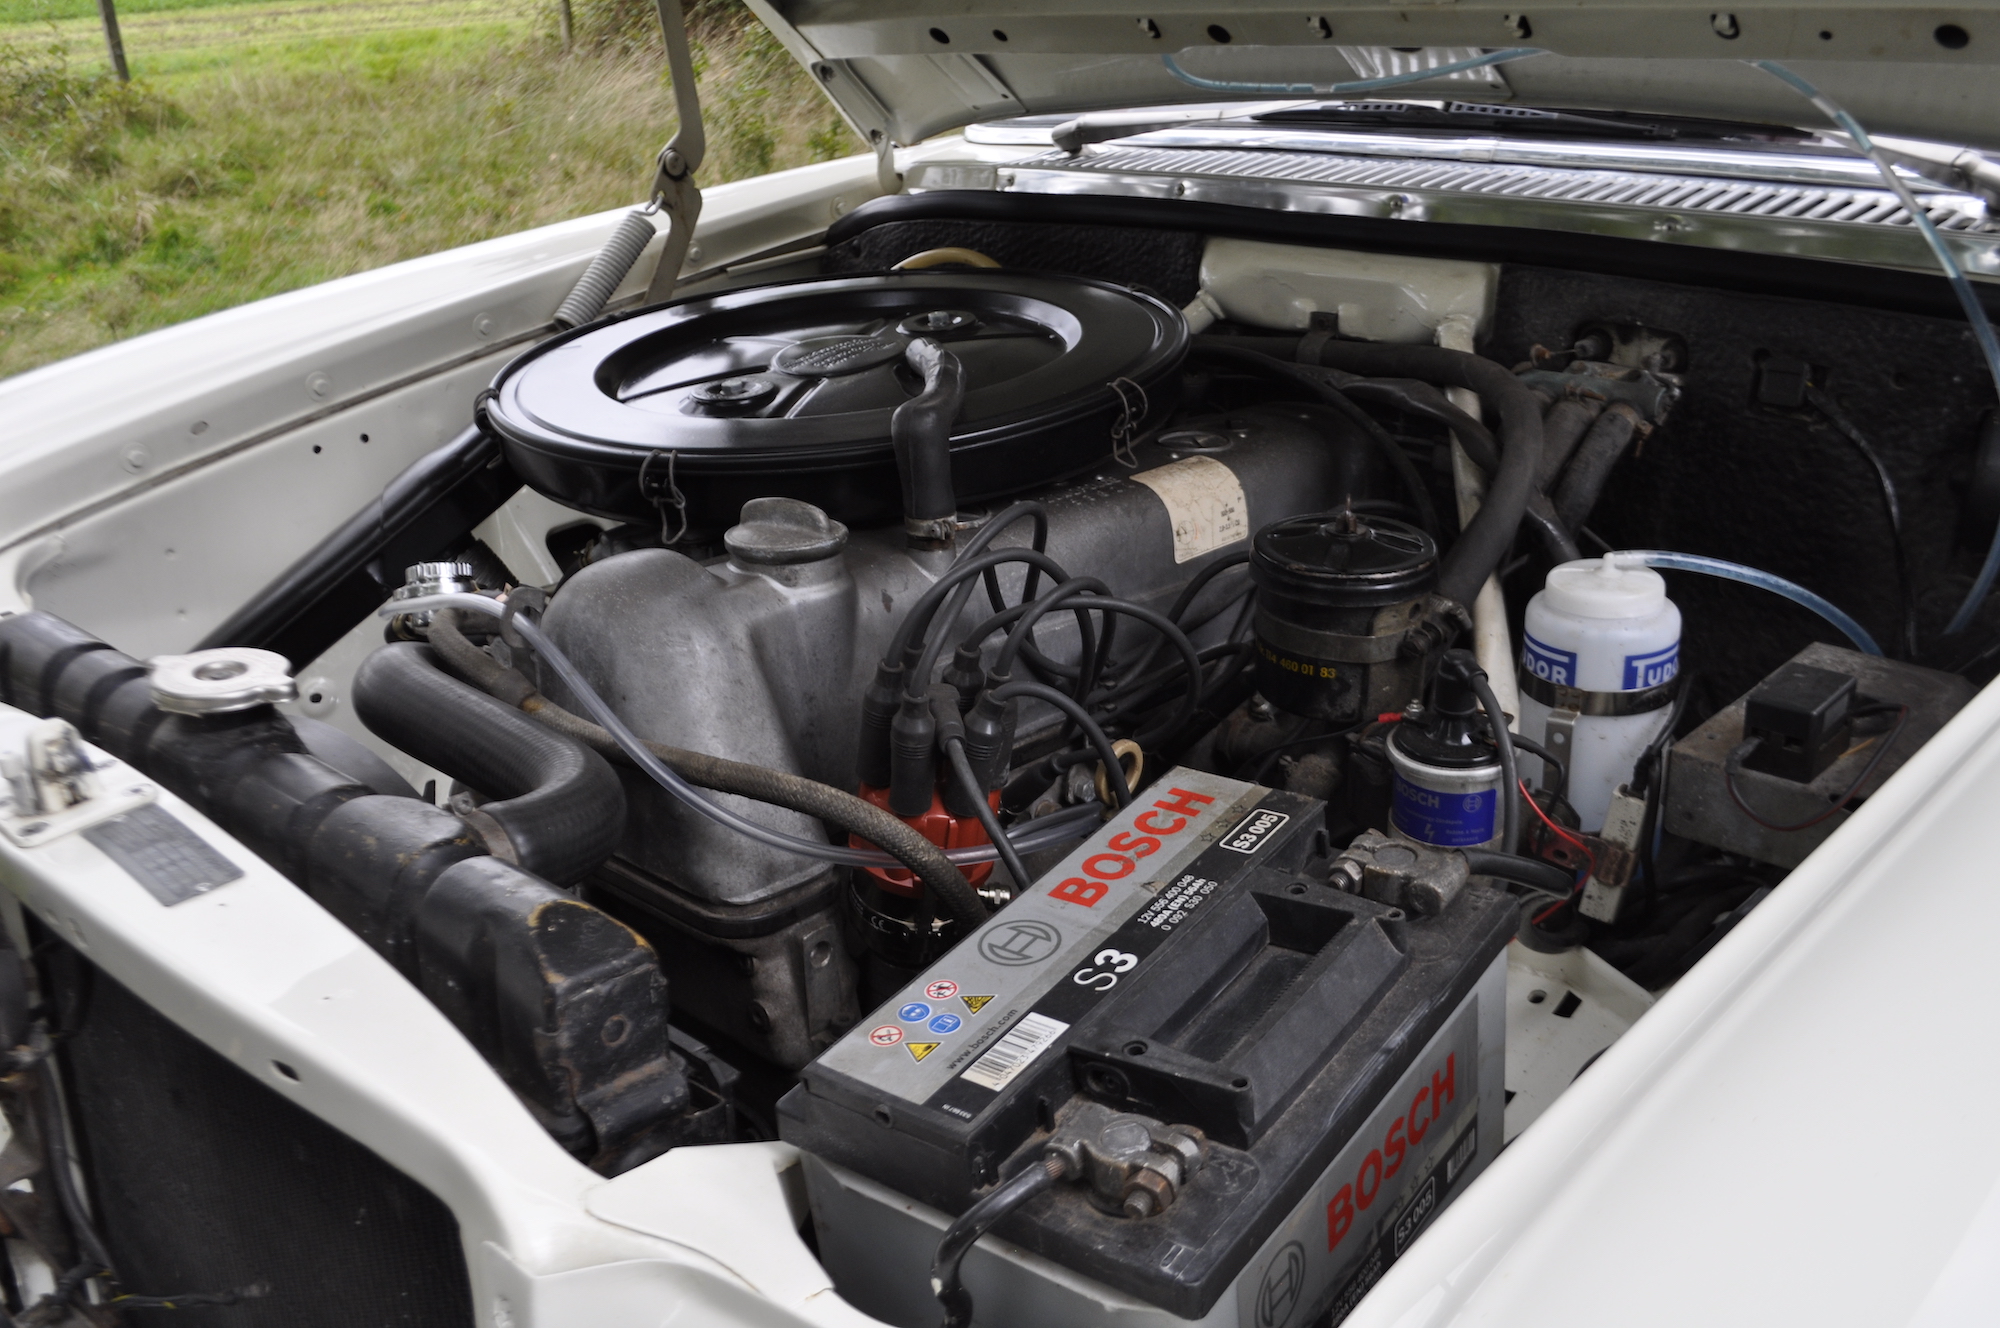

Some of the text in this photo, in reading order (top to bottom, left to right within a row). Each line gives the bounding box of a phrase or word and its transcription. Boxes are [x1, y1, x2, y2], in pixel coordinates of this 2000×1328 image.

[1279, 657, 1299, 672] 460
[1301, 663, 1315, 676] 01
[1319, 666, 1337, 679] 83
[1631, 643, 1679, 689] TUDO
[1395, 777, 1440, 809] BOSCH
[1047, 787, 1216, 907] BOSCH
[1232, 814, 1278, 849] S3 005
[1137, 874, 1194, 924] 12V 556 400 048
[1167, 894, 1189, 910] (EN)
[1183, 878, 1207, 896] 56Ah
[1168, 910, 1187, 924] 092
[1184, 895, 1203, 909] S30
[1200, 881, 1218, 894] 050
[1073, 948, 1138, 991] S3
[946, 1008, 1018, 1071] www.bosch.com
[999, 1055, 1029, 1080] 047023
[1327, 1051, 1455, 1254] BOSCH
[1398, 1189, 1432, 1244] S3 005
